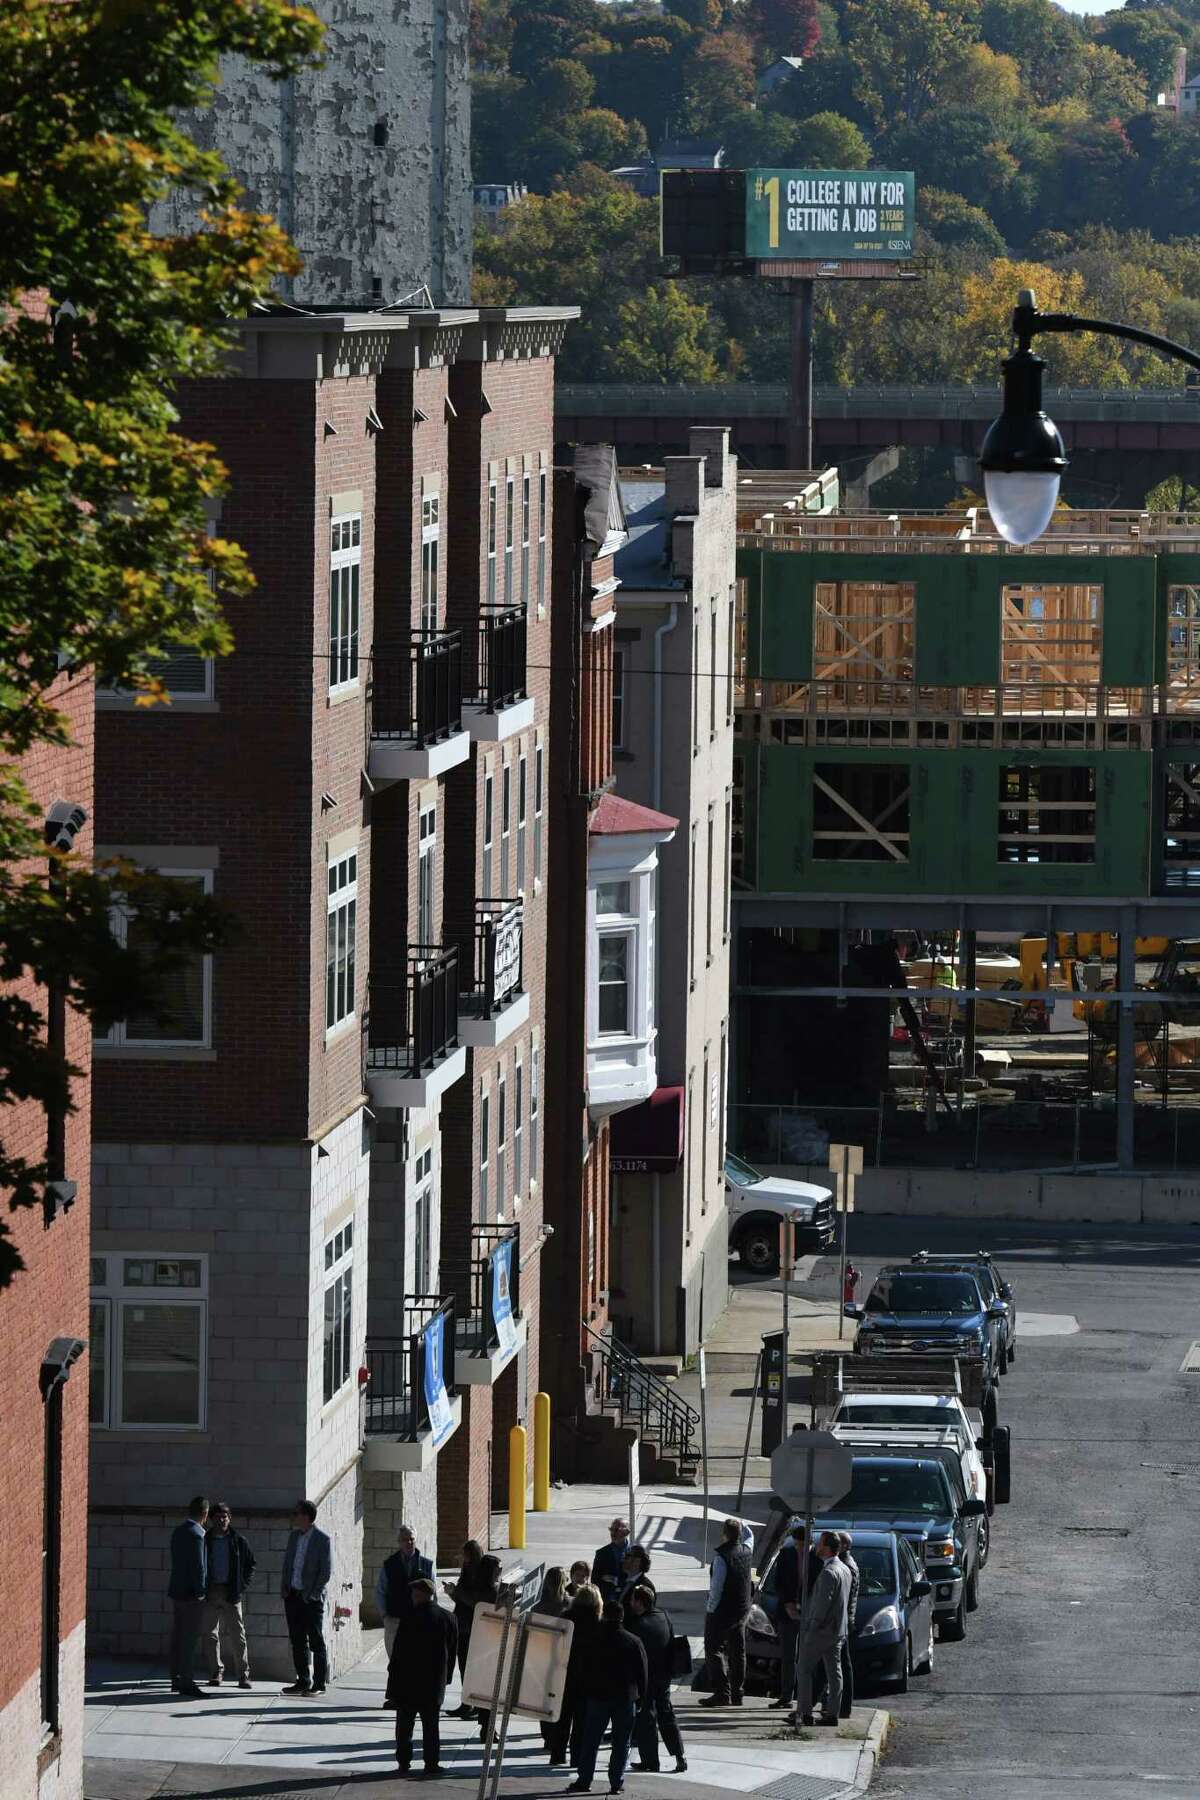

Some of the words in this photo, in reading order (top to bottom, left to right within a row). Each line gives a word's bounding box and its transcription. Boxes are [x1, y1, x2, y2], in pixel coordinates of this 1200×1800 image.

[787, 180, 840, 205] COLLEGE
[845, 181, 857, 205] IN
[861, 182, 877, 206] NY
[880, 182, 905, 206] FOR
[755, 176, 780, 248] #1
[787, 207, 838, 232] GETTING
[842, 208, 851, 232] A
[854, 209, 877, 233] JOB
[886, 209, 905, 221] YEARS
[772, 1349, 780, 1362] P
